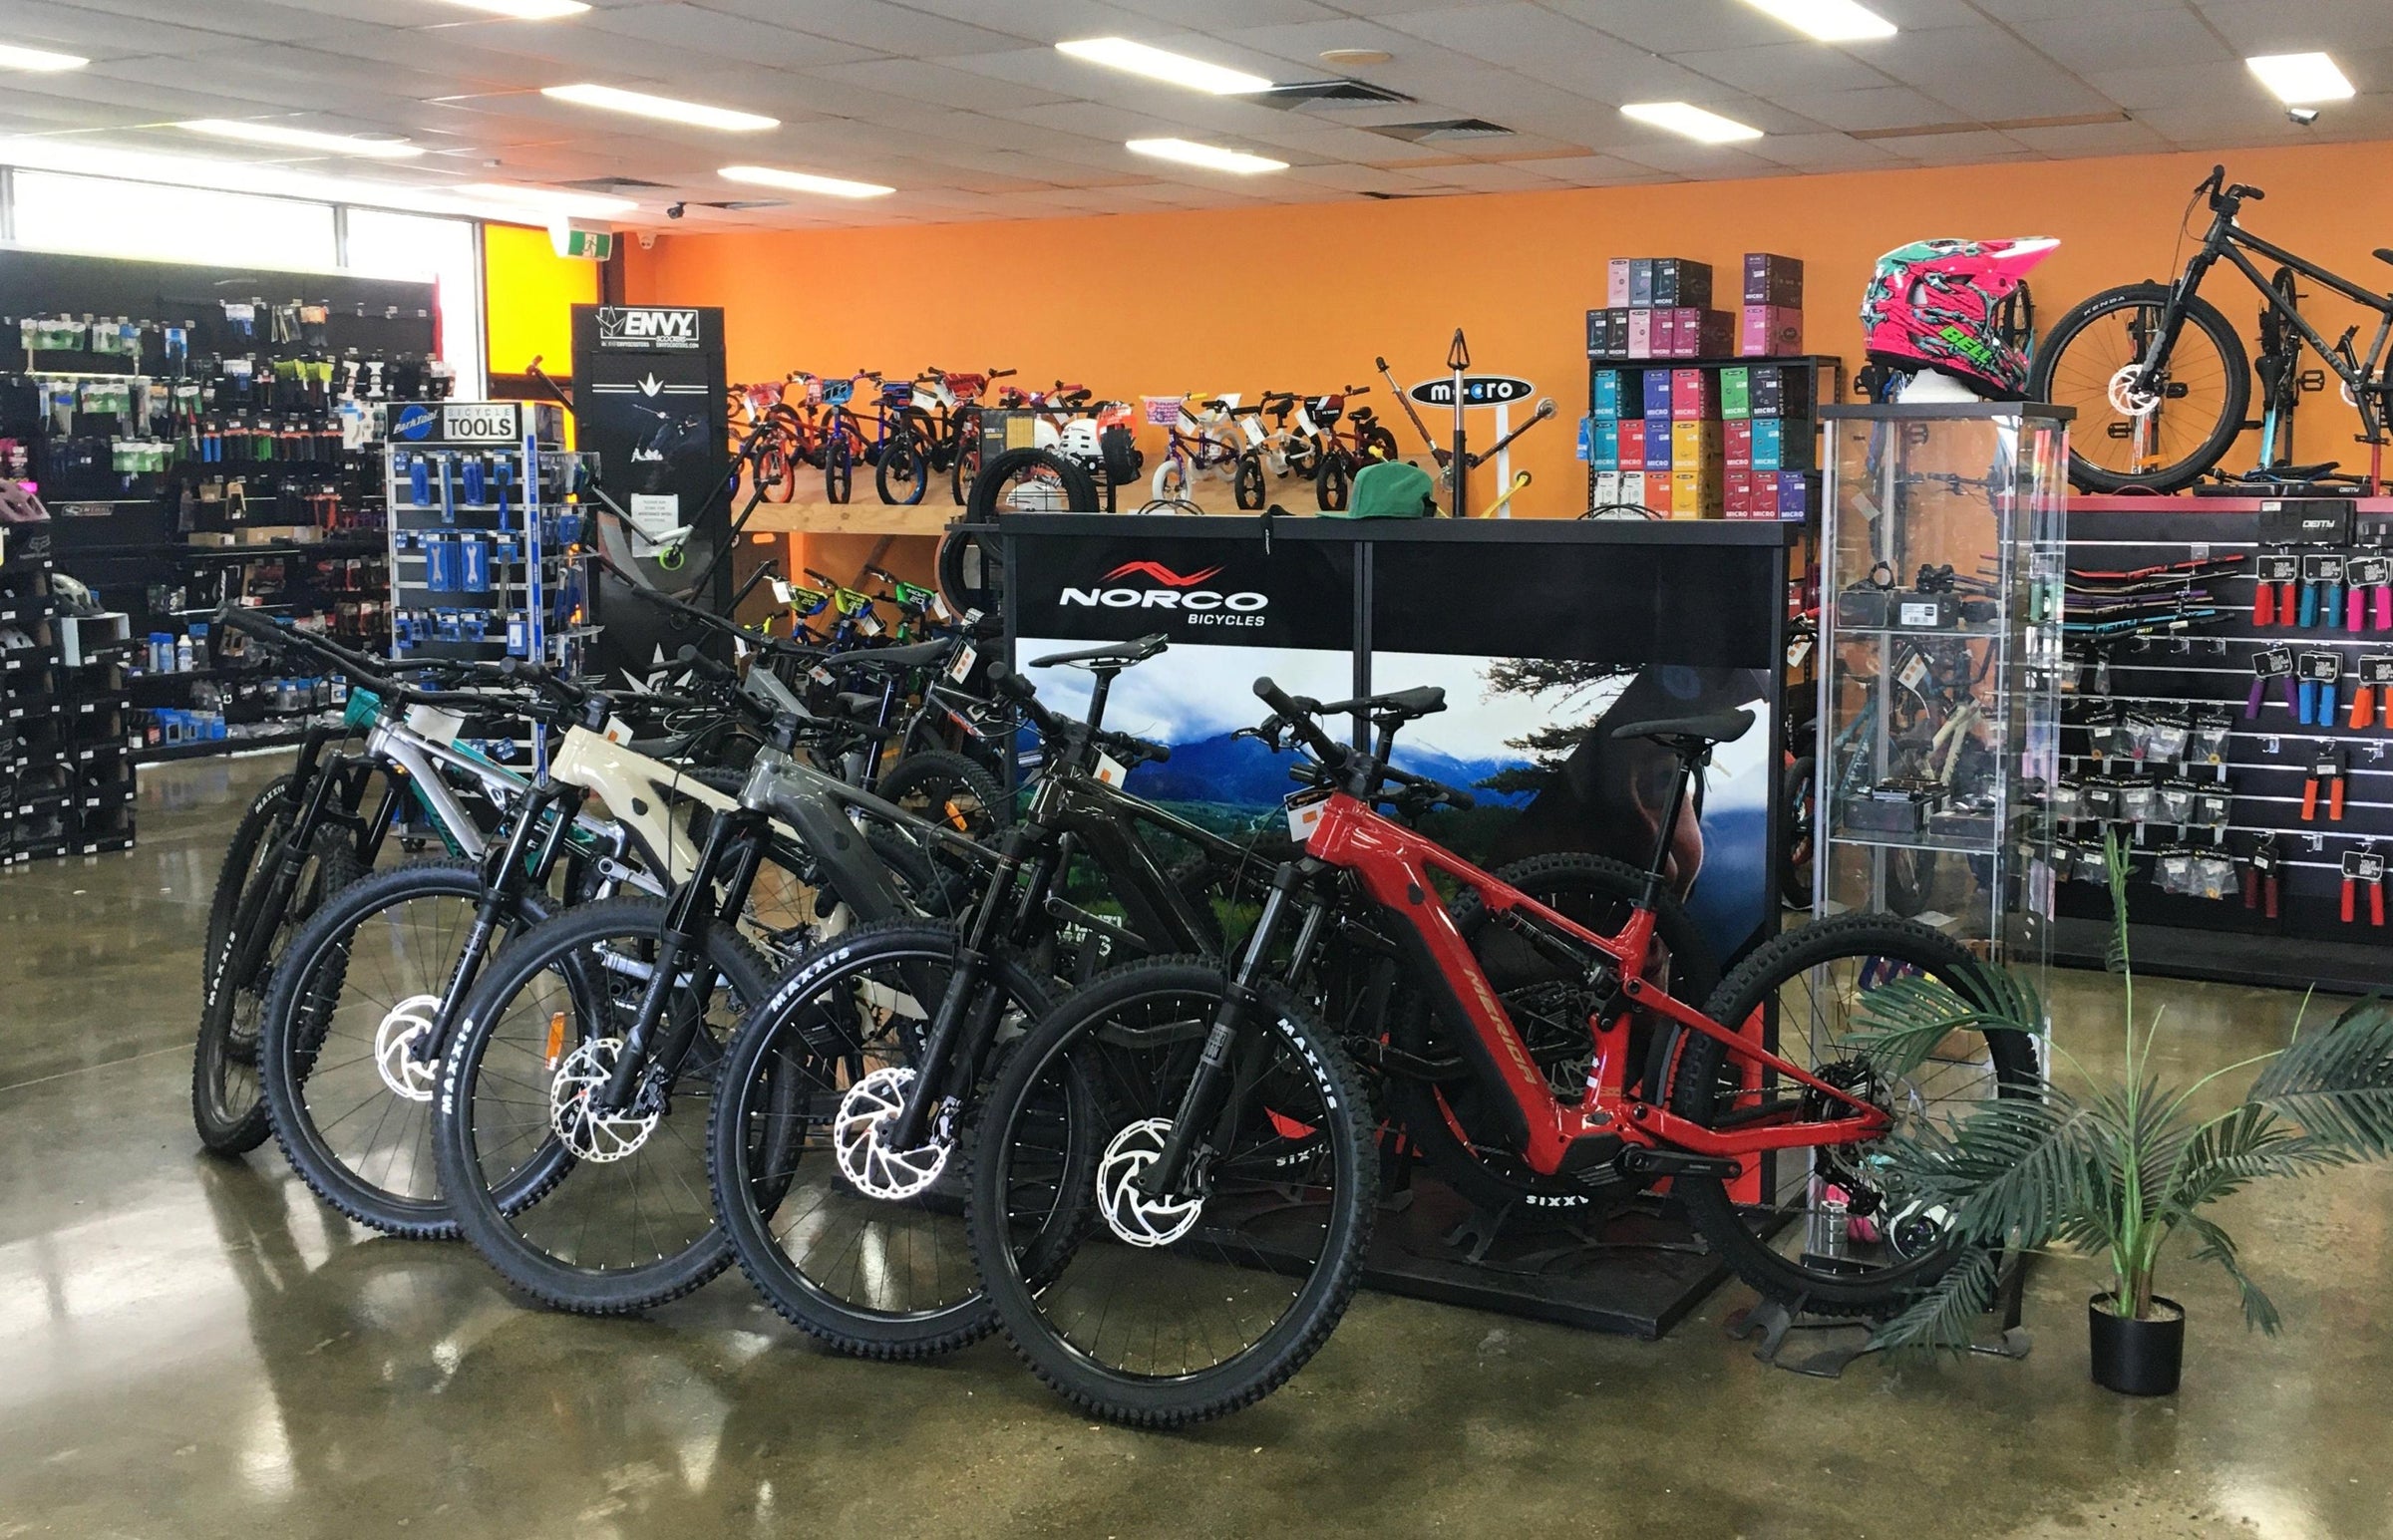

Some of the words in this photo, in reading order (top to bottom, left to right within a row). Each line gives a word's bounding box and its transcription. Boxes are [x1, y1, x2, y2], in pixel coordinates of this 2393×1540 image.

[2083, 295, 2126, 316] KENDA
[1938, 326, 1992, 364] BELL
[448, 419, 512, 437] TOOLS
[1059, 587, 1268, 611] NORCO
[1188, 614, 1265, 626] BICYCLES
[254, 784, 286, 814] MAXXIS
[208, 931, 236, 1006] MAXXIS
[769, 947, 851, 1013] MAXXIS
[638, 972, 662, 1019] marzocchi
[1463, 968, 1538, 1084] MERIDA
[442, 1018, 474, 1114] MAXXIS
[1276, 1018, 1337, 1109] MAXXIS
